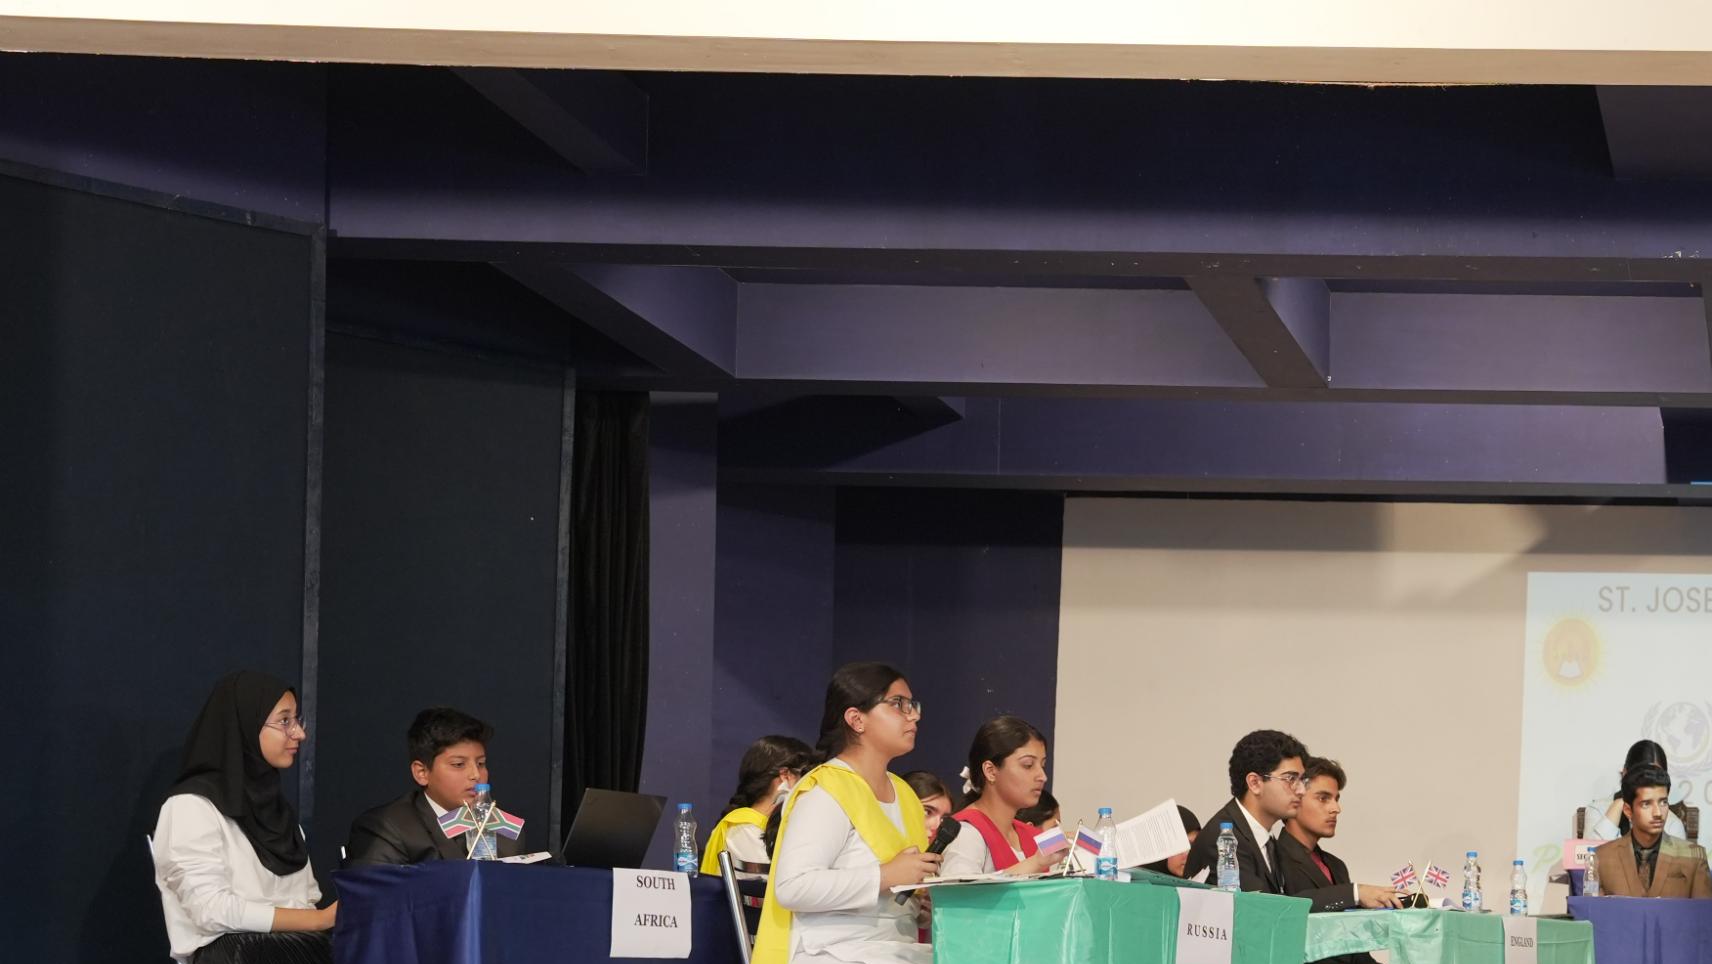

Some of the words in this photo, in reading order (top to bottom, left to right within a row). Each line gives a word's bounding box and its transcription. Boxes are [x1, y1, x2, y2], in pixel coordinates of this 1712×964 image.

[1598, 586, 1636, 613] ST.
[636, 875, 676, 890] SOUTH
[634, 913, 678, 929] AFRICA
[1186, 922, 1228, 941] RUSSIA
[1510, 935, 1534, 948] ENGLAND
